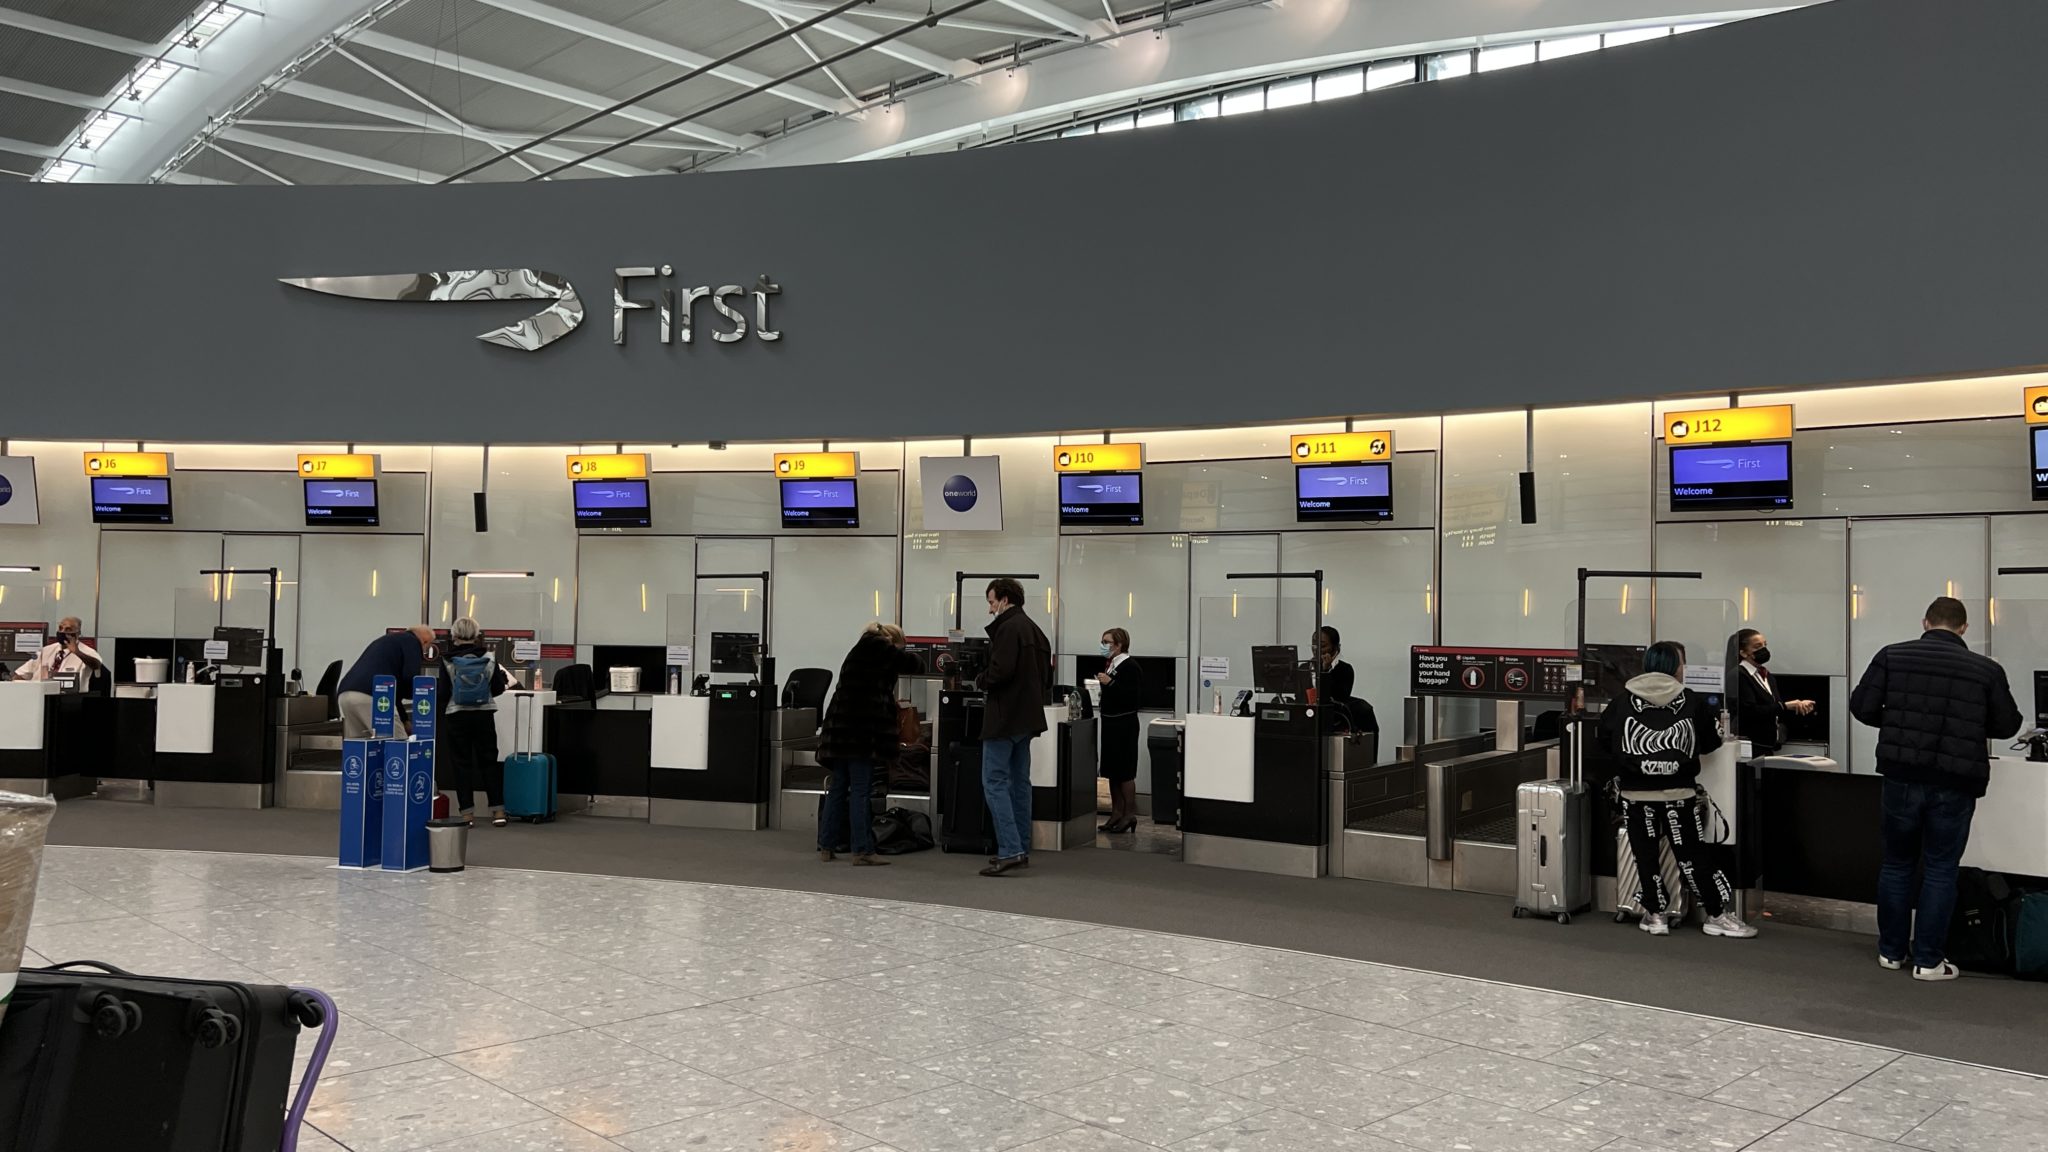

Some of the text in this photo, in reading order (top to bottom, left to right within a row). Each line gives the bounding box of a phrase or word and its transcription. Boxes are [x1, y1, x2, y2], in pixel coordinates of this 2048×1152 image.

[613, 264, 780, 345] First
[1694, 419, 1722, 433] J12
[1314, 442, 1337, 454] J11
[1075, 452, 1094, 463] J10
[105, 459, 117, 469] J6
[316, 461, 327, 471] J7
[586, 462, 597, 472] J8
[794, 460, 805, 470] J9
[1738, 458, 1761, 469] First
[1349, 476, 1368, 485] First
[136, 487, 152, 495] First
[345, 489, 360, 498] First
[823, 489, 839, 498] First
[1105, 484, 1122, 493] First
[1674, 487, 1713, 496] Welcome
[616, 490, 631, 498] First
[1299, 500, 1331, 508] Welcome
[1418, 677, 1449, 685] baggage?
[1667, 809, 1683, 846] Colour
